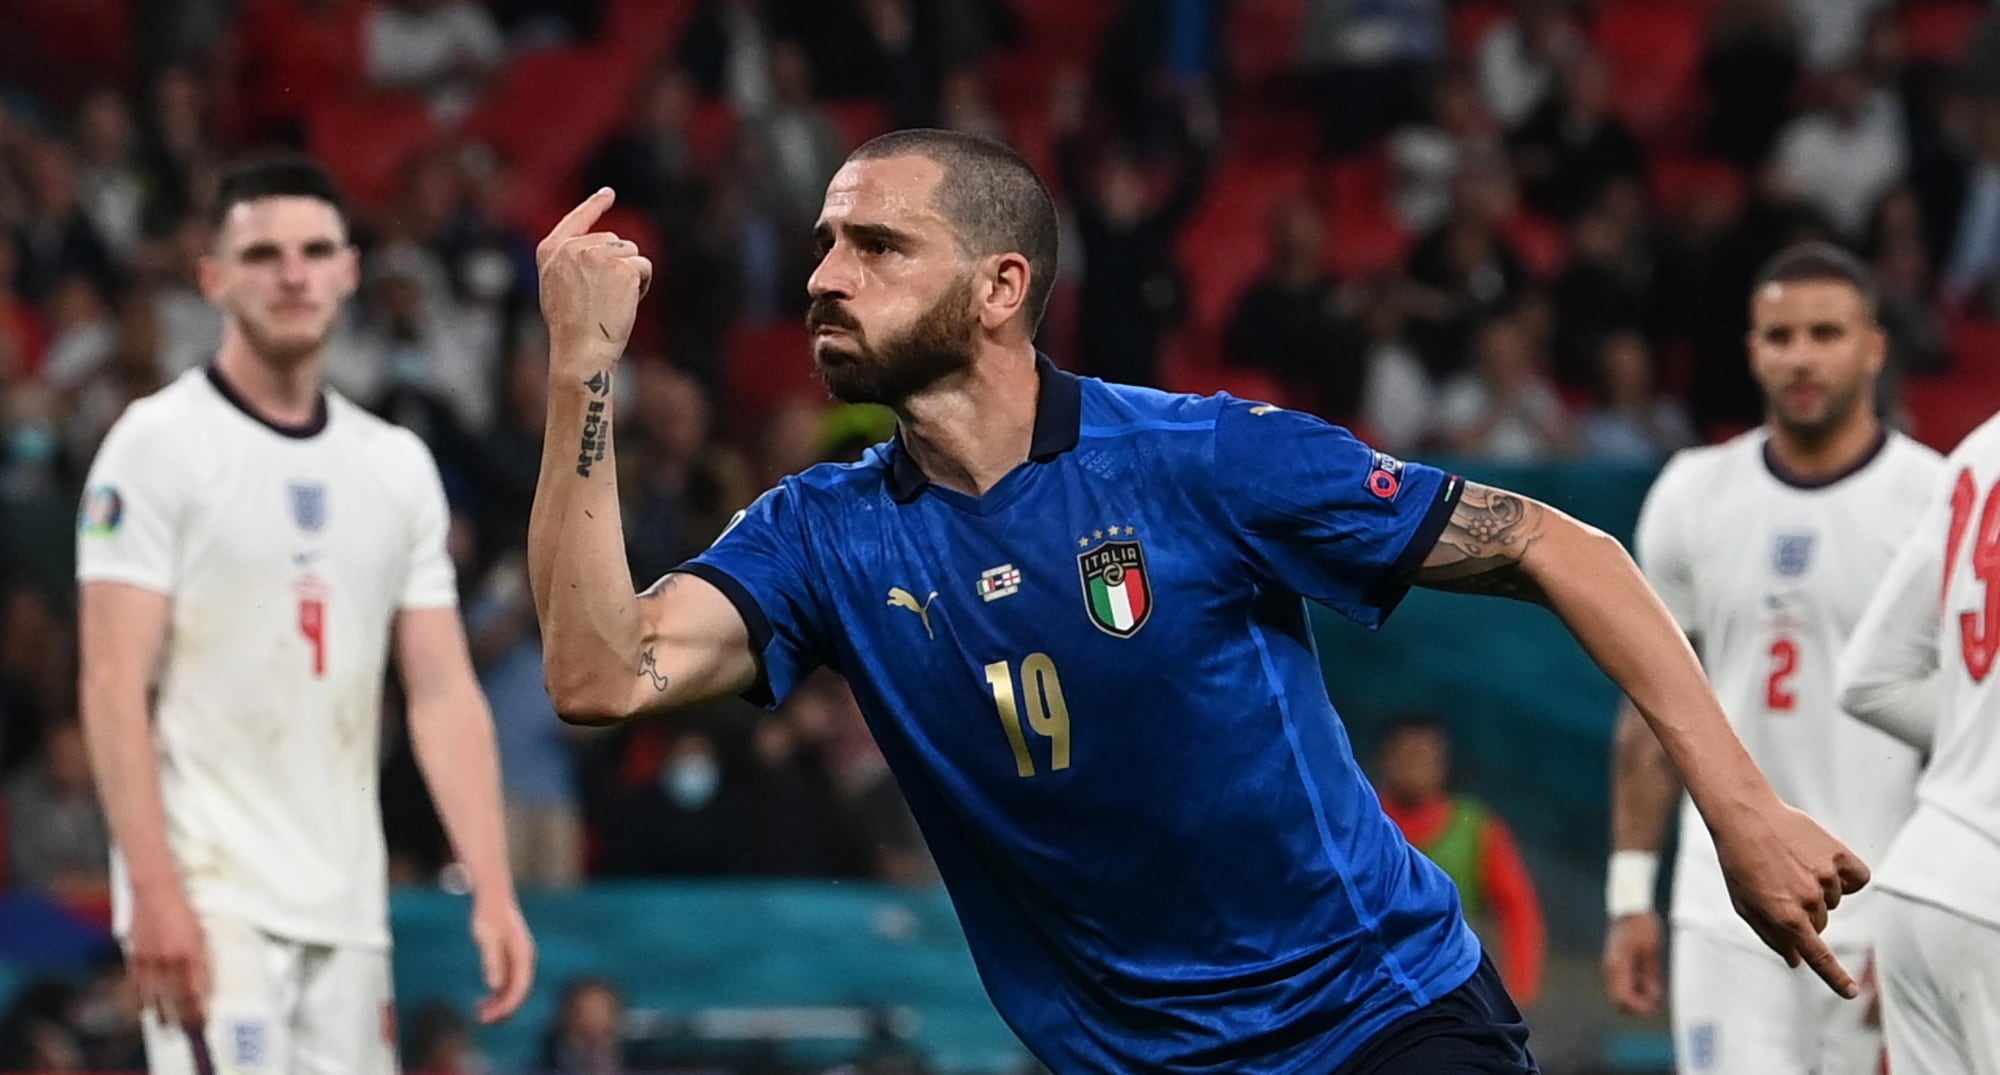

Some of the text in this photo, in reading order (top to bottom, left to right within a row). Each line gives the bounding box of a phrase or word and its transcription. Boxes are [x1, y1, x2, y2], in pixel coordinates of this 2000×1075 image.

[1085, 547, 1137, 571] ITALIA
[298, 600, 327, 678] 4
[1767, 639, 1798, 709] 2
[985, 653, 1070, 777] 19
